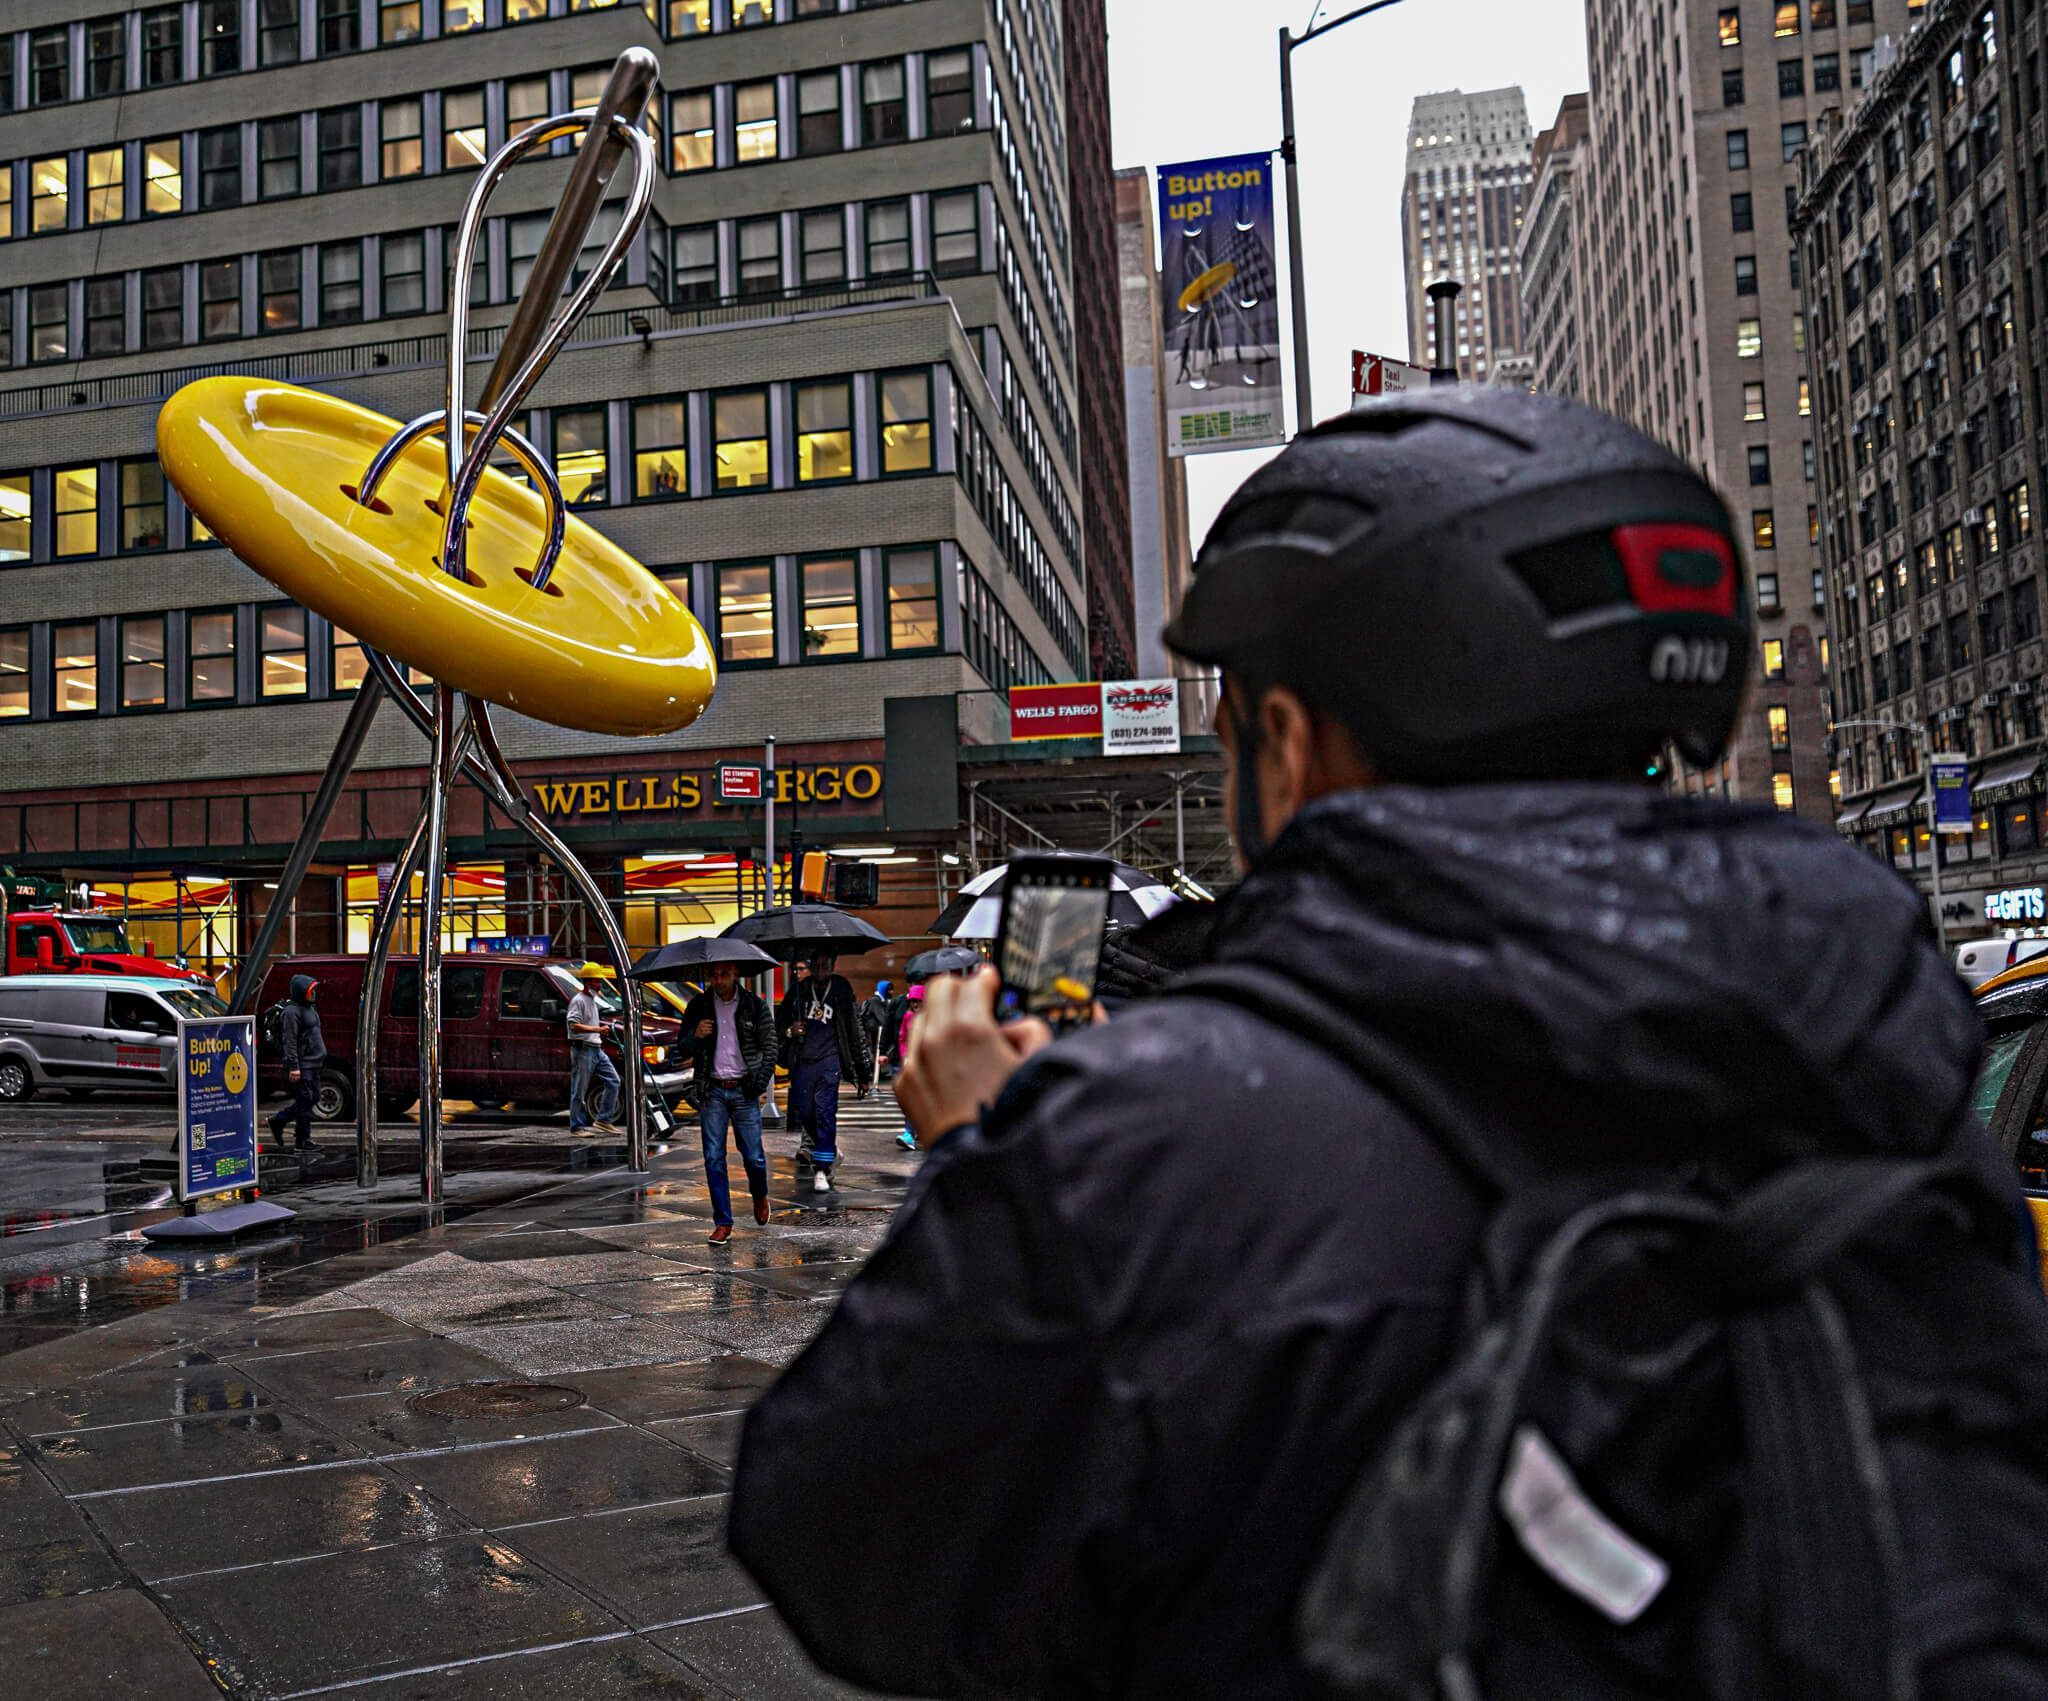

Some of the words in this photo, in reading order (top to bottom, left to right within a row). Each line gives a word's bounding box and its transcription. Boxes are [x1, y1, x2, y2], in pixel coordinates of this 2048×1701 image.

[1168, 170, 1261, 196] Button
[1169, 196, 1212, 221] up!
[1385, 368, 1400, 381] Taxi
[1111, 694, 1168, 704] ARSENAL
[1015, 706, 1055, 719] WELLS
[1058, 704, 1098, 717] FARGO
[1111, 728, 1131, 740] (631)
[534, 775, 701, 815] WELLS
[713, 764, 882, 807] RGO
[2000, 887, 2044, 920] GIFTS
[190, 1037, 231, 1055] Button
[190, 1057, 211, 1077] Up!
